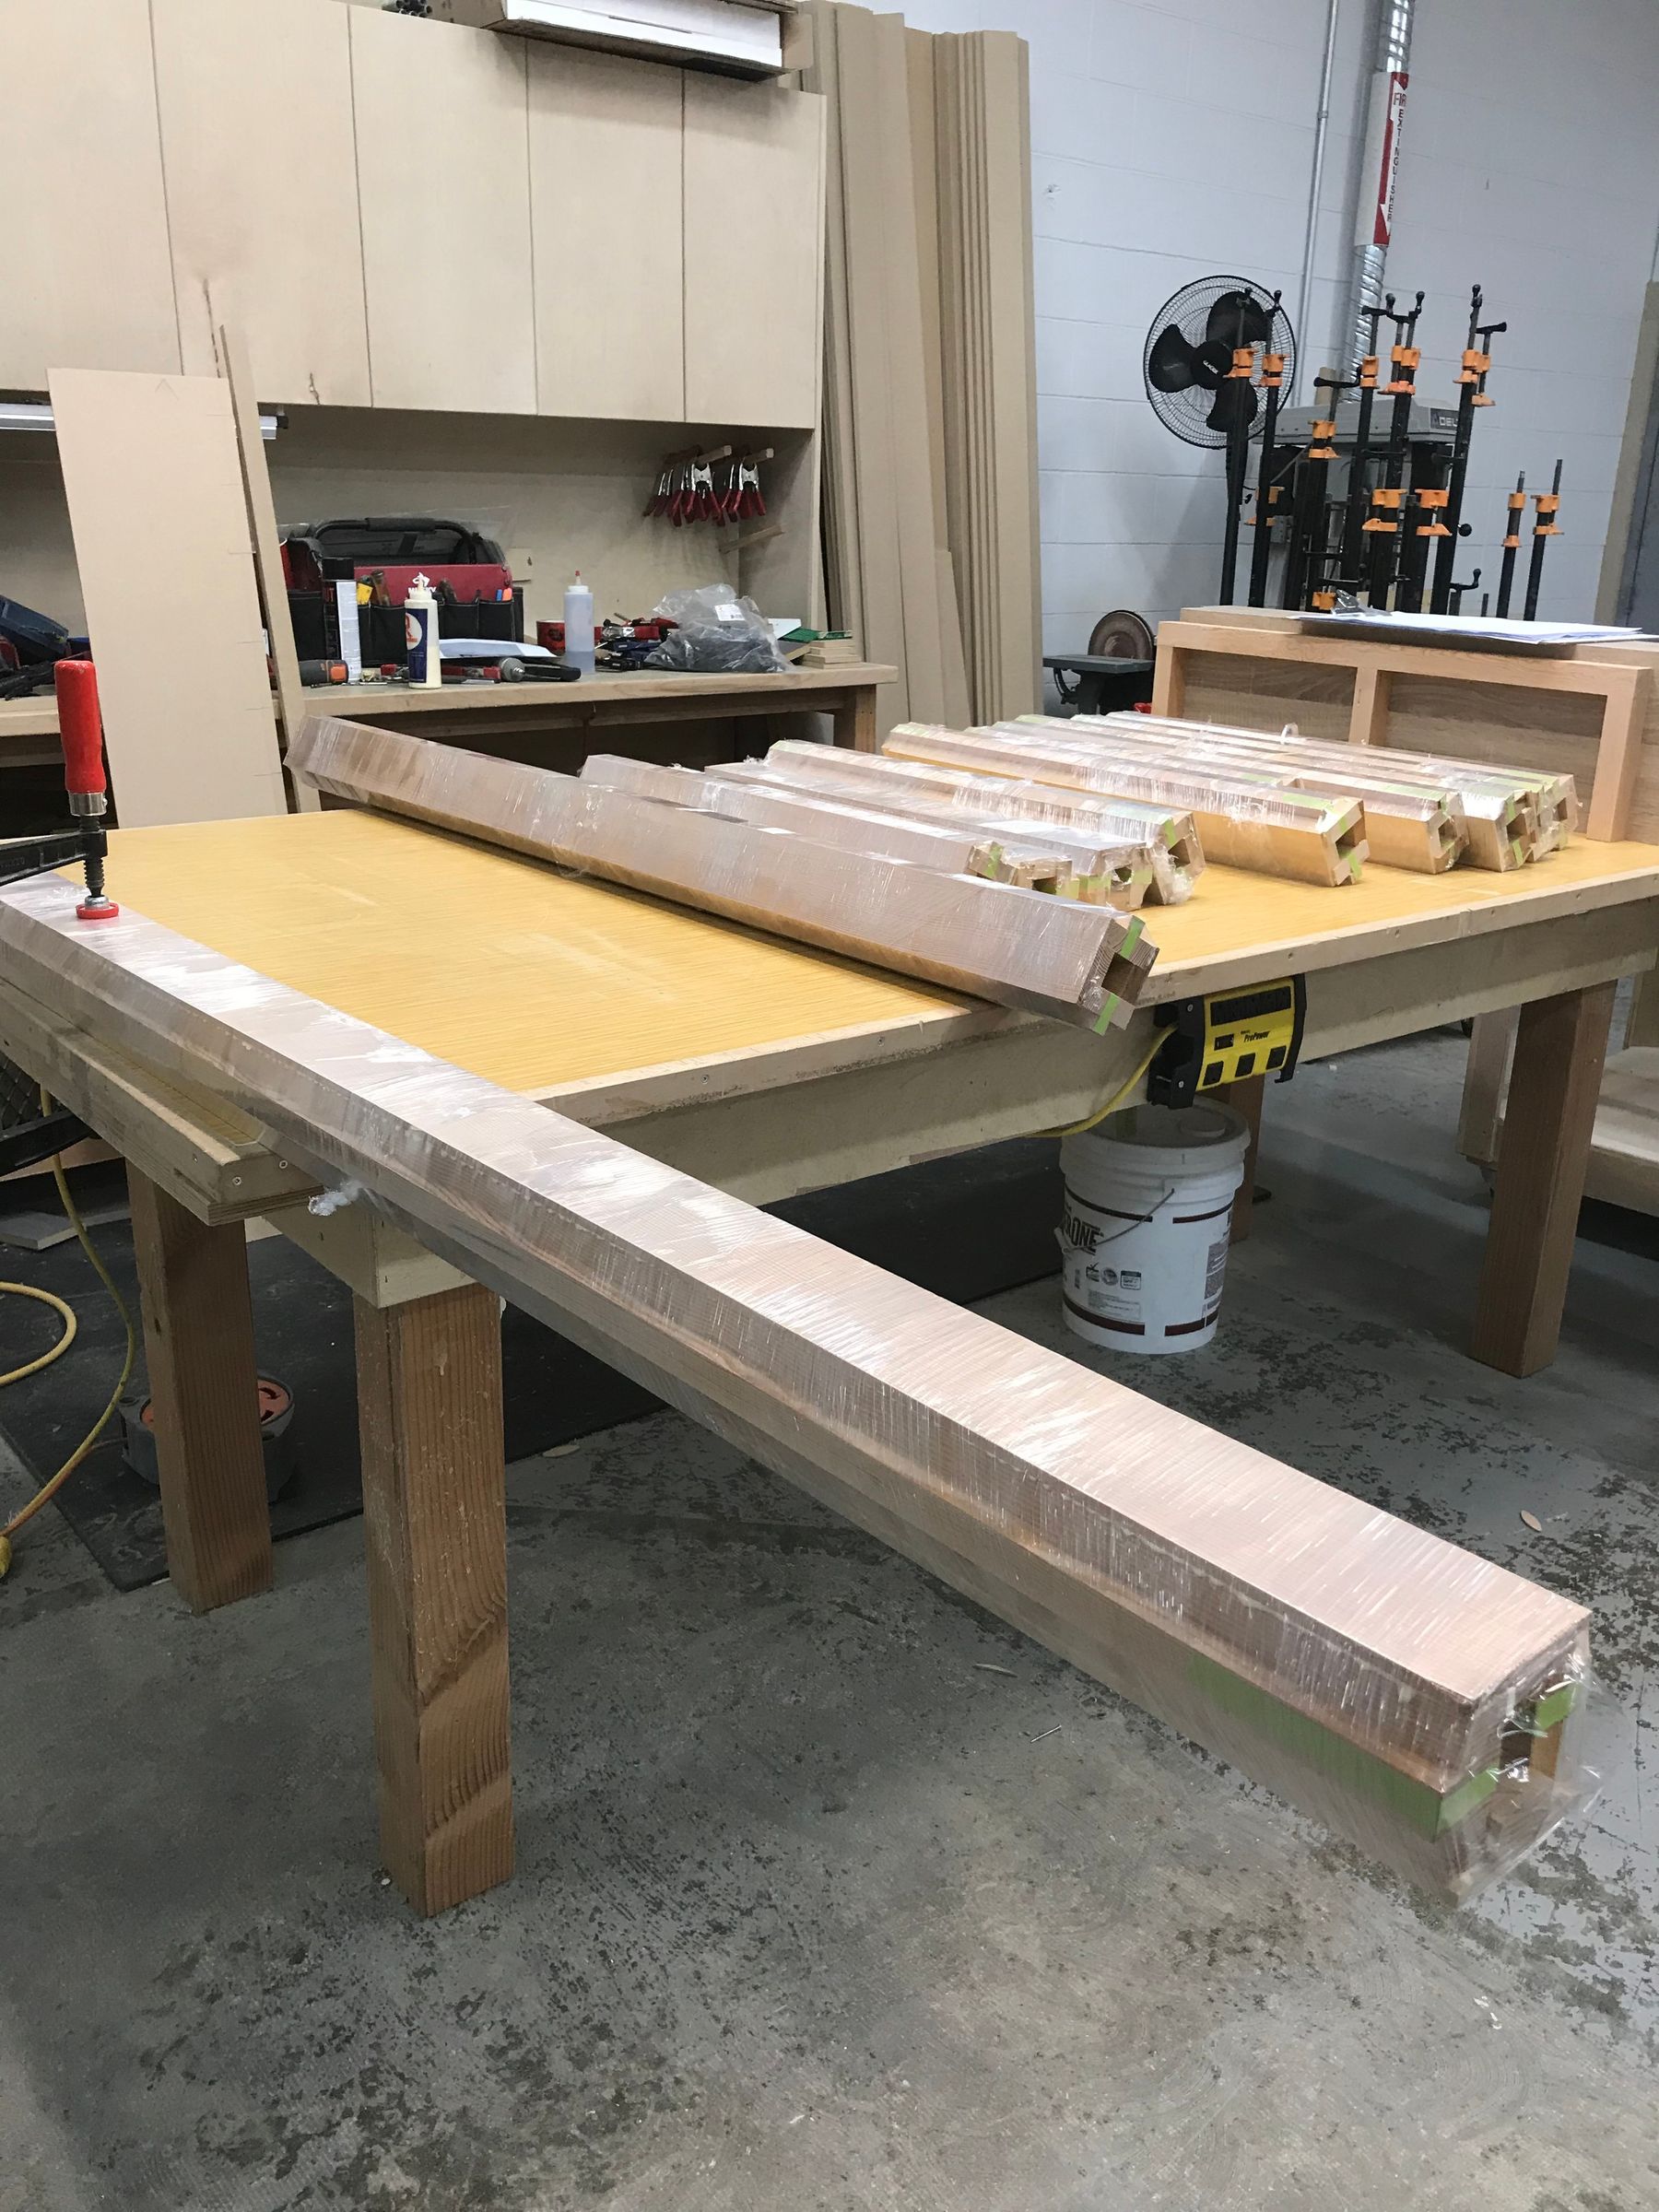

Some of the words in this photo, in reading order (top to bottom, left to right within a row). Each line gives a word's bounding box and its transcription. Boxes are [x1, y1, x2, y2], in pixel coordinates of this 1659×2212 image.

[1393, 92, 1407, 107] FIR
[1386, 109, 1405, 222] EXTINGUISHER
[1439, 416, 1458, 428] DEL
[1244, 1030, 1270, 1043] ProPower
